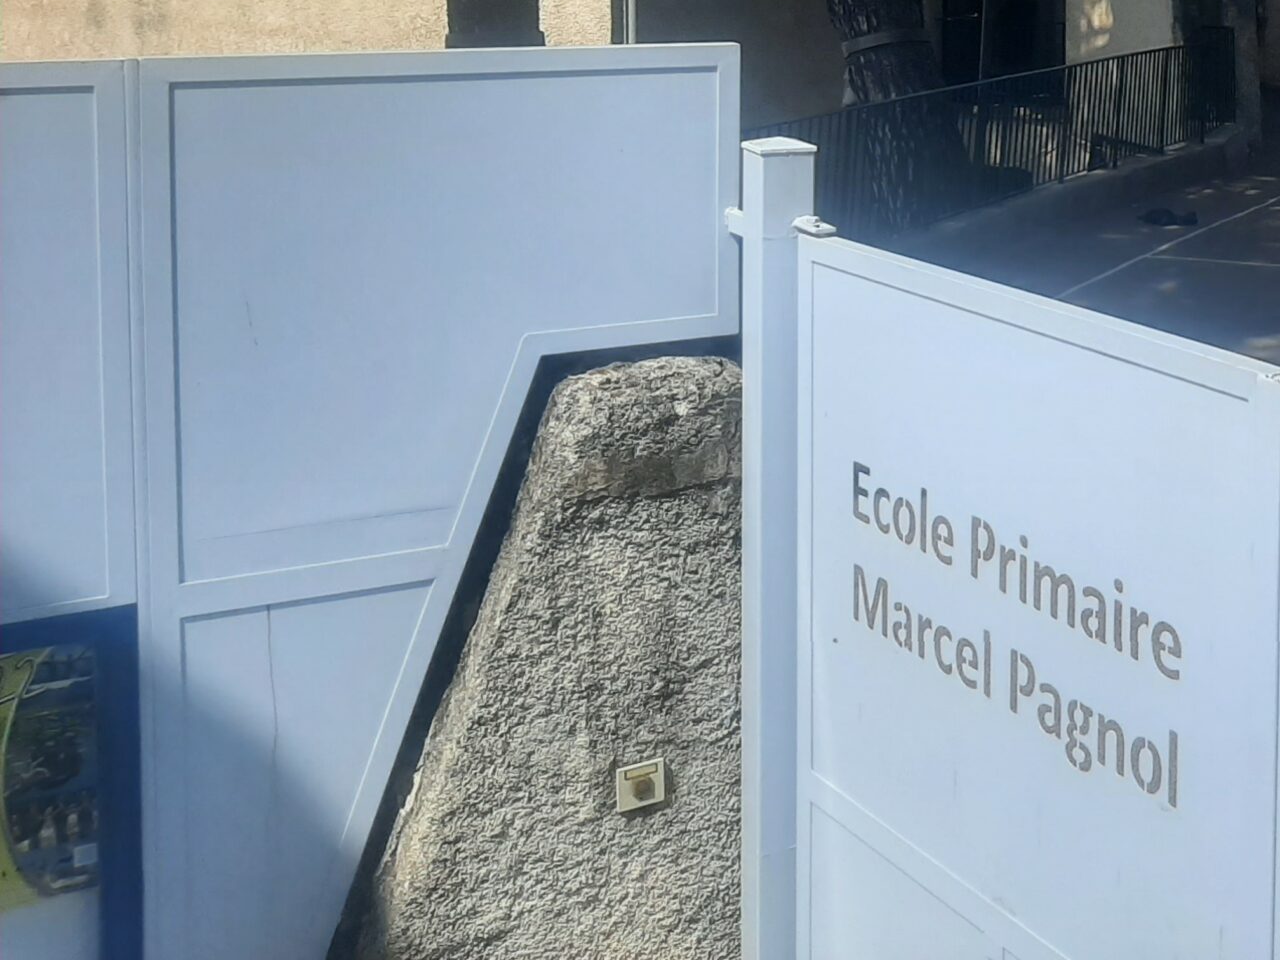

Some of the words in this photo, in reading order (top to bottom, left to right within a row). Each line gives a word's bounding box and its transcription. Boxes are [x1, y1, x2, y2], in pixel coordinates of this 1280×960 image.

[852, 461, 954, 566] Ecole
[970, 515, 1182, 680] Primaire
[853, 563, 991, 698] Marcel
[1009, 648, 1178, 808] Pagnol
